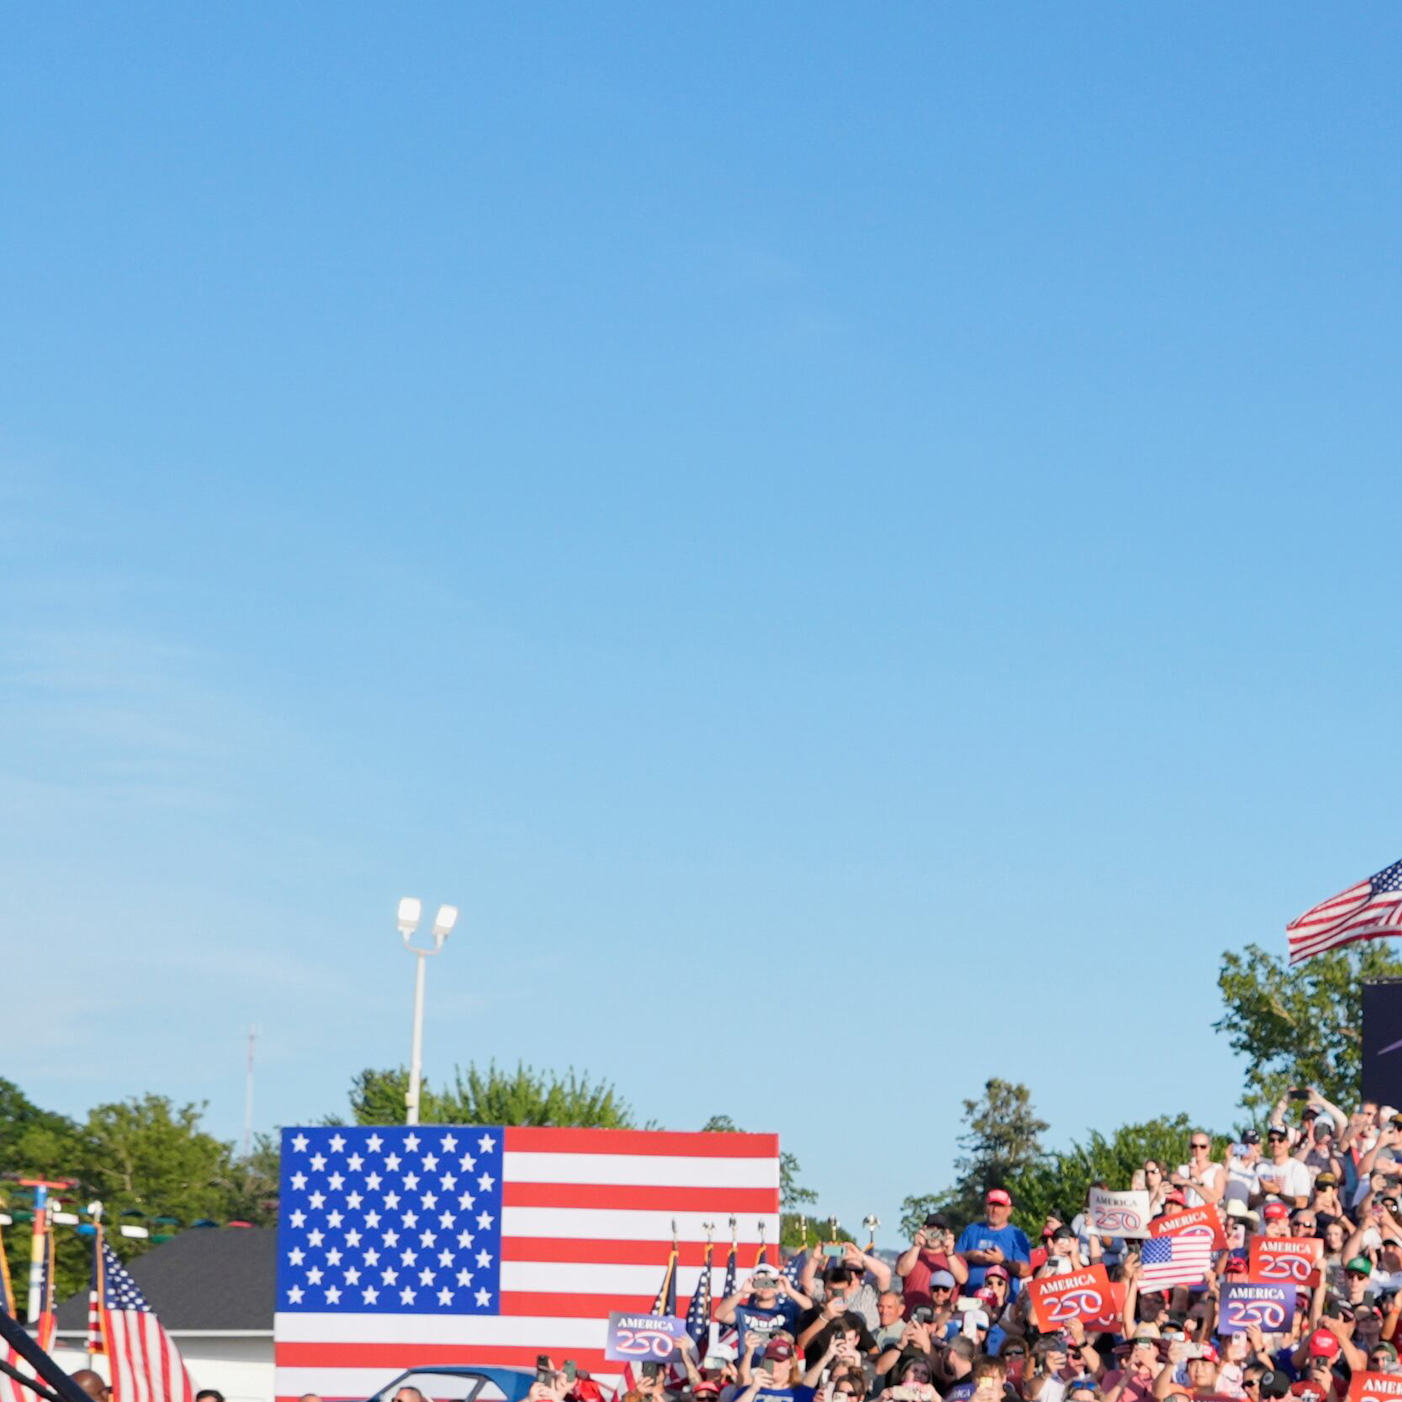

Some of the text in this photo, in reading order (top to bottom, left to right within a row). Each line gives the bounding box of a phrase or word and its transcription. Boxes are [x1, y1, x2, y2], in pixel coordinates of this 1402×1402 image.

[1158, 1210, 1208, 1233] AMERICA
[1259, 1241, 1312, 1254] AMERICA
[1258, 1254, 1312, 1281] 250
[1039, 1273, 1096, 1295] AMERICA
[1228, 1288, 1285, 1300] AMERICA
[1043, 1289, 1103, 1322] 250
[1228, 1301, 1286, 1328] 250
[617, 1317, 674, 1331] AMERICA
[615, 1329, 674, 1357] 250
